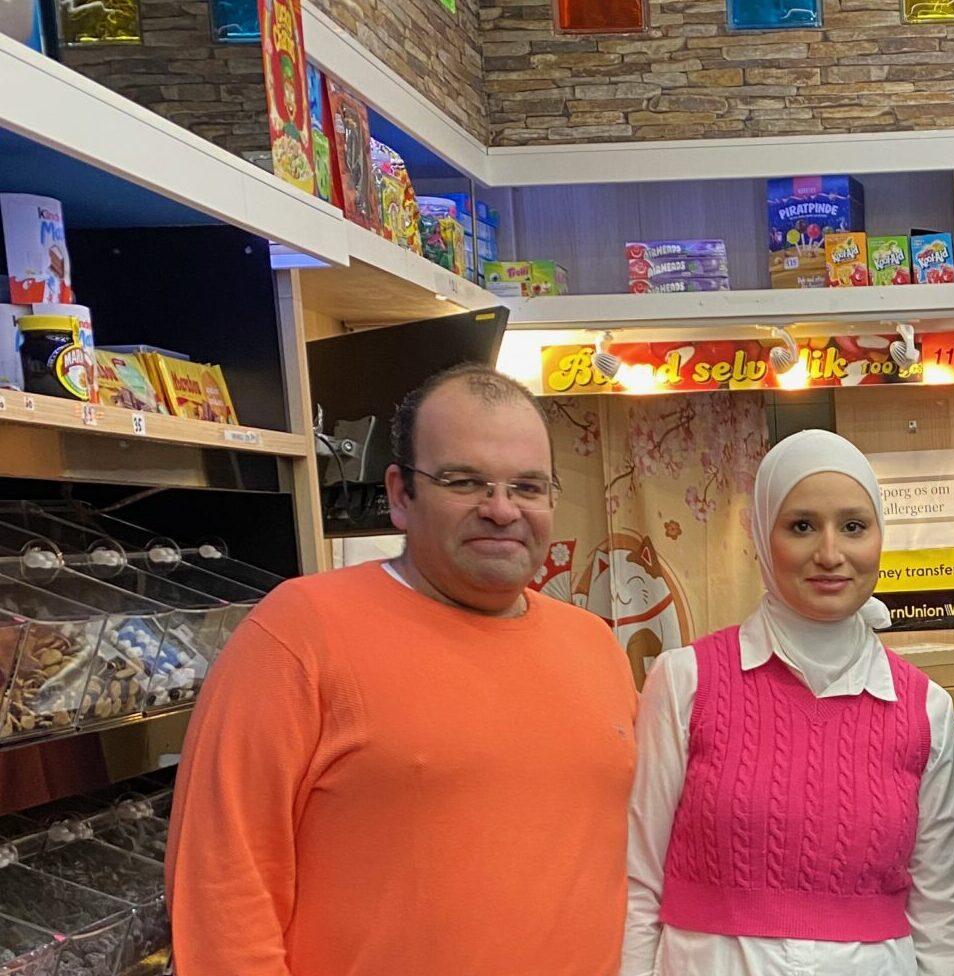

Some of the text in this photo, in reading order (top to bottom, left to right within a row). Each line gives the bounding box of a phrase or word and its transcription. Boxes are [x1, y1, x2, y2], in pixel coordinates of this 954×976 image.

[778, 202, 839, 220] PIRATPINDE
[692, 349, 767, 383] selv
[914, 486, 928, 496] os
[931, 486, 950, 496] om
[883, 503, 945, 517] allergener
[878, 569, 901, 580] ney
[889, 604, 945, 619] rnUnion
